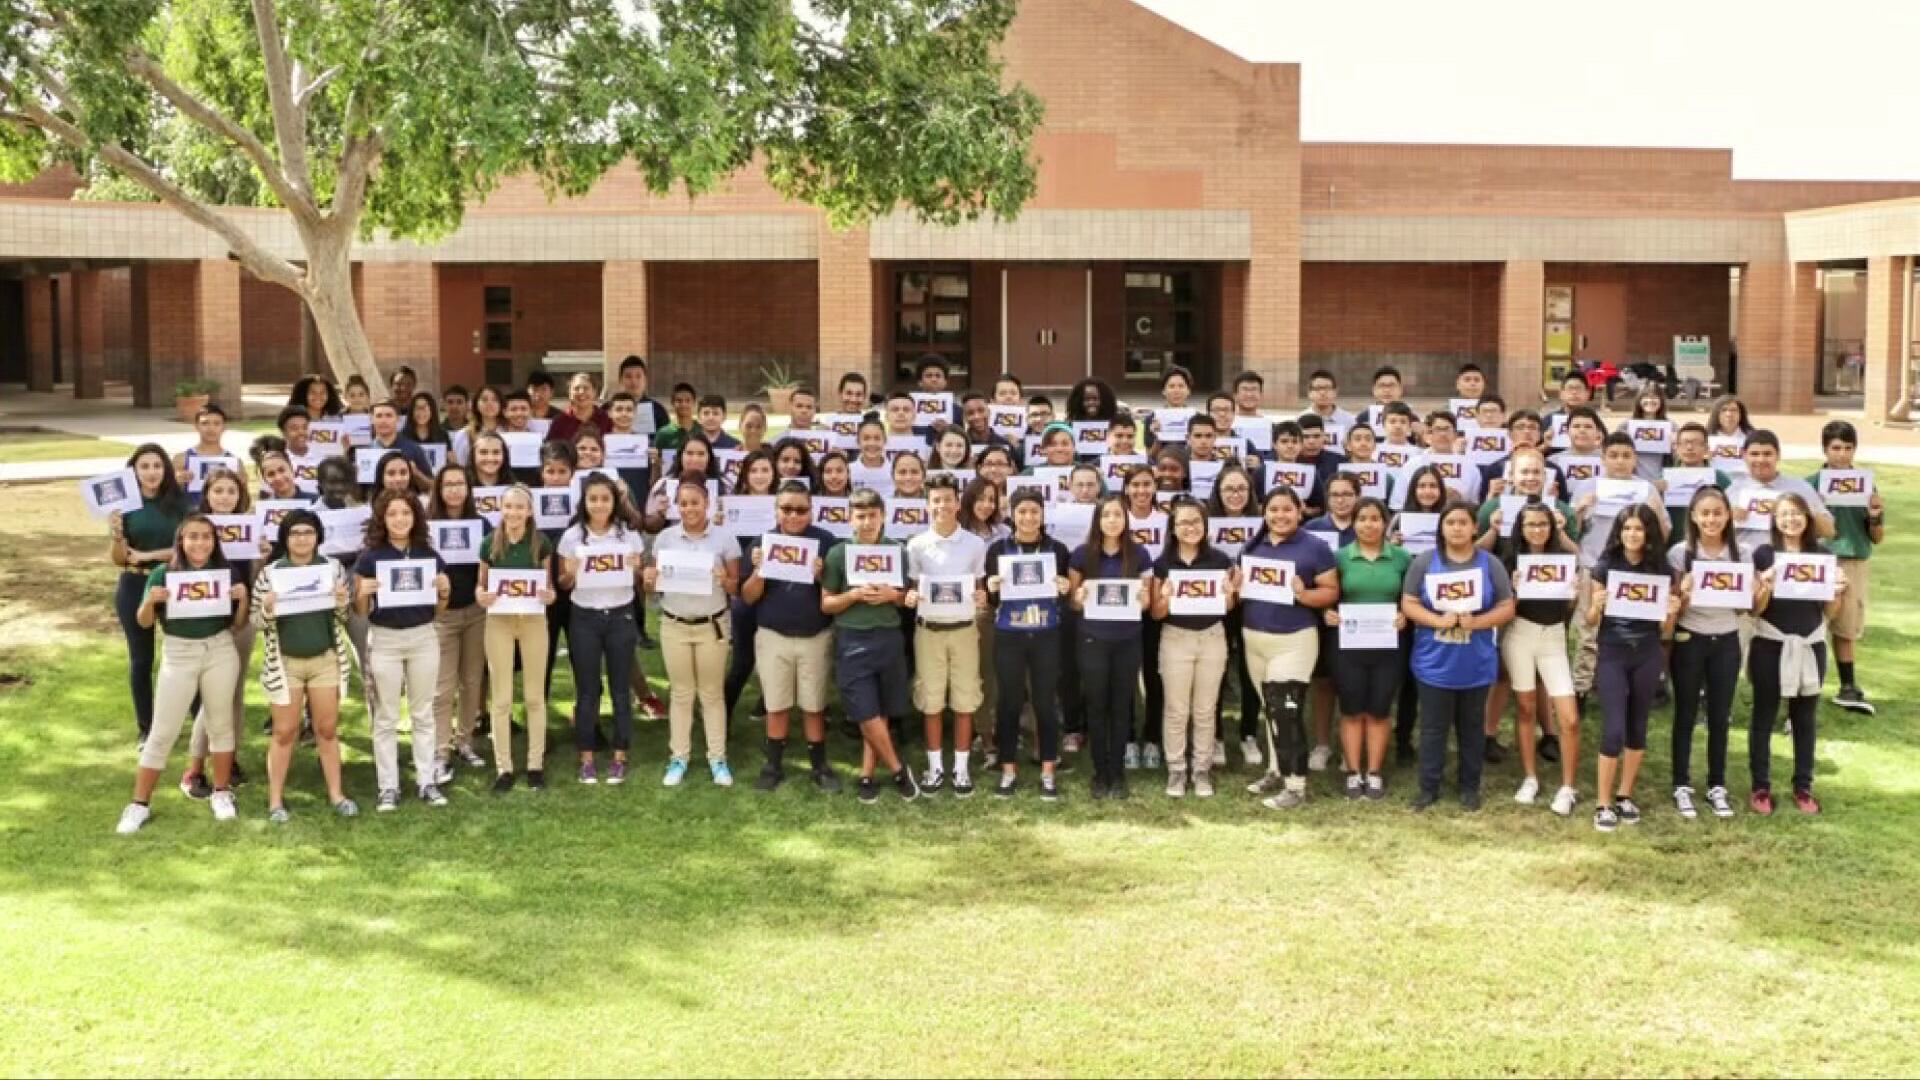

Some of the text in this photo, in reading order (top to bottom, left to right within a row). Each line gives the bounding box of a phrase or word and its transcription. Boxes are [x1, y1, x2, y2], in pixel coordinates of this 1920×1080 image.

[917, 398, 946, 413] ASU
[1457, 406, 1478, 419] AS
[994, 413, 1024, 427] ASU
[1079, 429, 1107, 442] ASU
[1634, 427, 1664, 441] ASU
[1472, 436, 1505, 451] ASU
[295, 464, 318, 480] AS
[1273, 470, 1306, 487] ASU
[1566, 464, 1600, 480] ASU
[1828, 477, 1865, 493] ASU
[1748, 498, 1774, 514] AS
[892, 508, 929, 524] ASU
[585, 554, 624, 572] ASU
[767, 543, 809, 566] ASU
[855, 554, 893, 572] ASU
[1250, 565, 1286, 586] ASU
[1527, 564, 1567, 582] ASU
[1701, 570, 1743, 592] ASU
[1782, 563, 1825, 583] ASU
[177, 580, 220, 601] ASU
[496, 579, 537, 597] ASU
[1177, 579, 1216, 598] ASU
[1436, 579, 1475, 601] ASU
[1615, 583, 1658, 603] ASU
